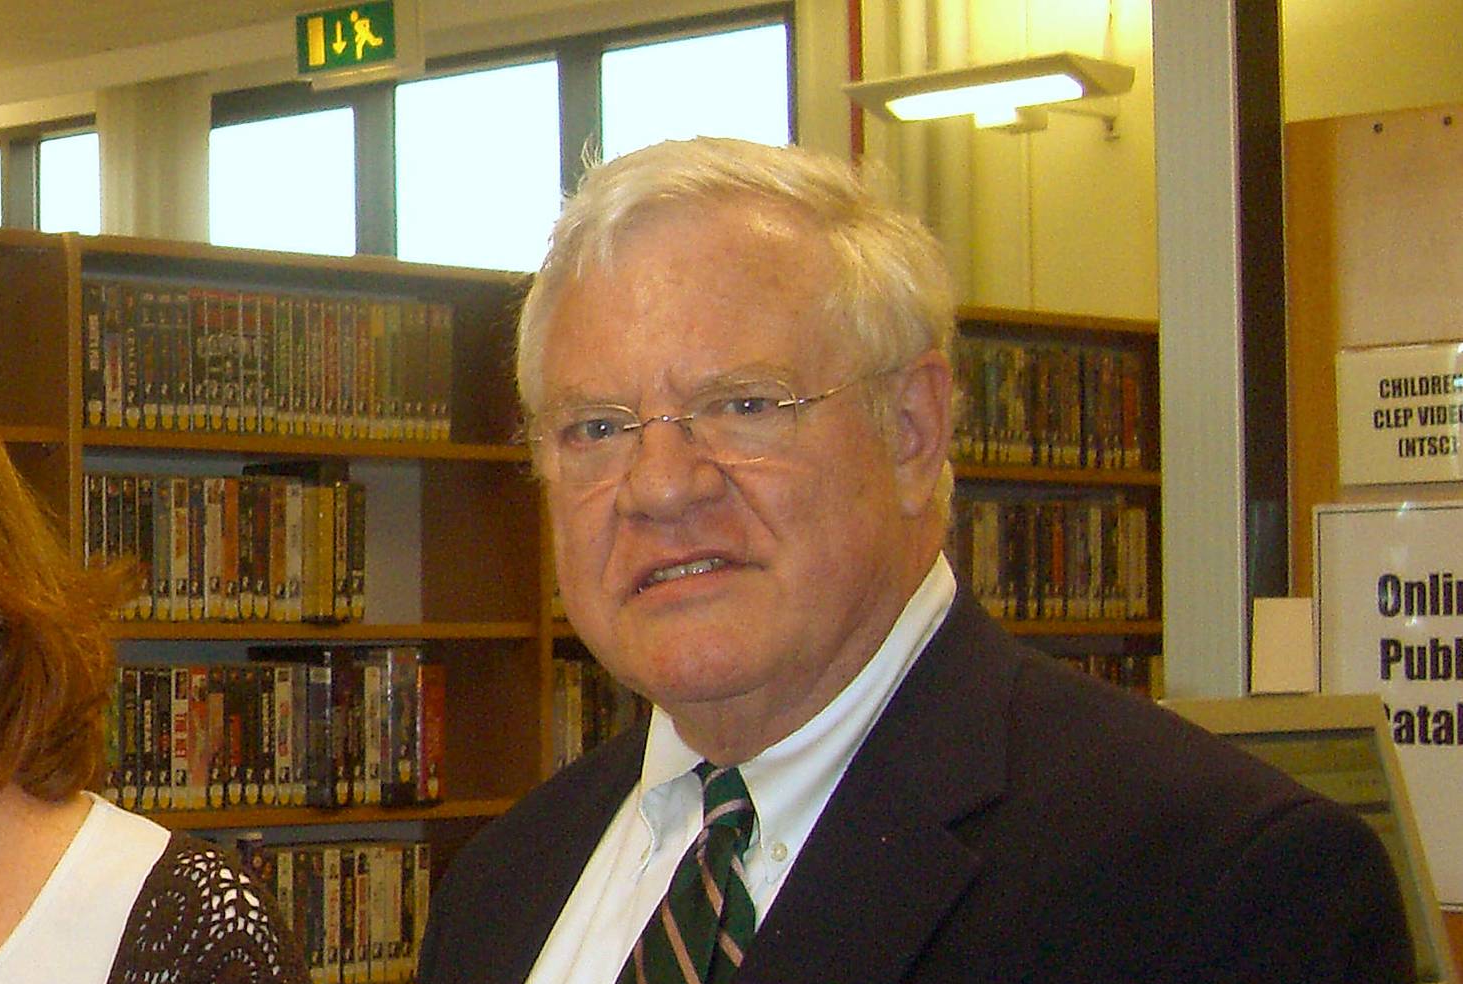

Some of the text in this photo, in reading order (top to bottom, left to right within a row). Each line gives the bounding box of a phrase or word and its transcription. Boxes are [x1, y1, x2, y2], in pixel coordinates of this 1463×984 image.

[1373, 408, 1413, 429] CLEP
[1398, 435, 1457, 458] (NTSC)
[1383, 702, 1463, 745] atal
